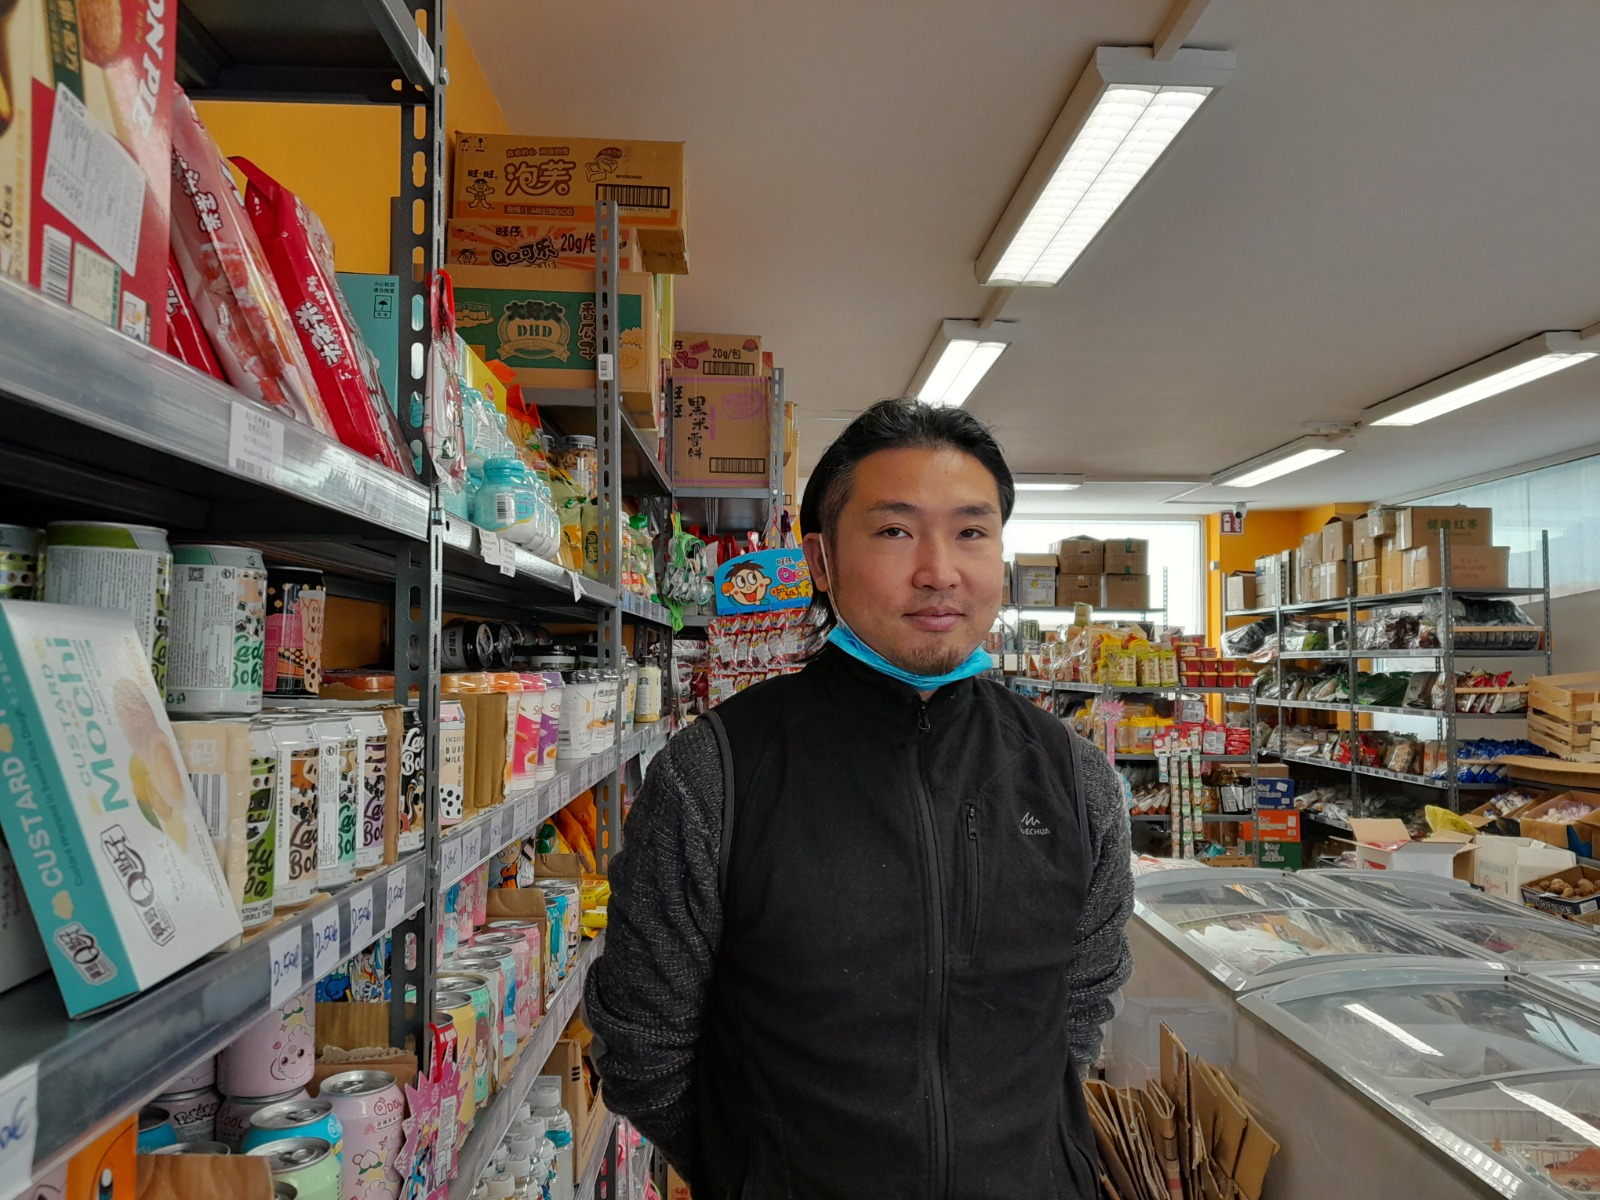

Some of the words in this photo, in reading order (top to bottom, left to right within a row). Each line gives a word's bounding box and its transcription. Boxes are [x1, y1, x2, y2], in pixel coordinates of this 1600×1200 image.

[132, 52, 161, 139] PIE
[504, 159, 576, 196] 泡芙
[495, 226, 521, 237] 旺仔
[295, 301, 343, 367] 米老头
[516, 324, 553, 338] DHD
[712, 348, 742, 360] 20g/包
[42, 663, 92, 788] CUSTARD
[46, 637, 129, 814] Mochi
[3, 757, 64, 887] CUSTARD
